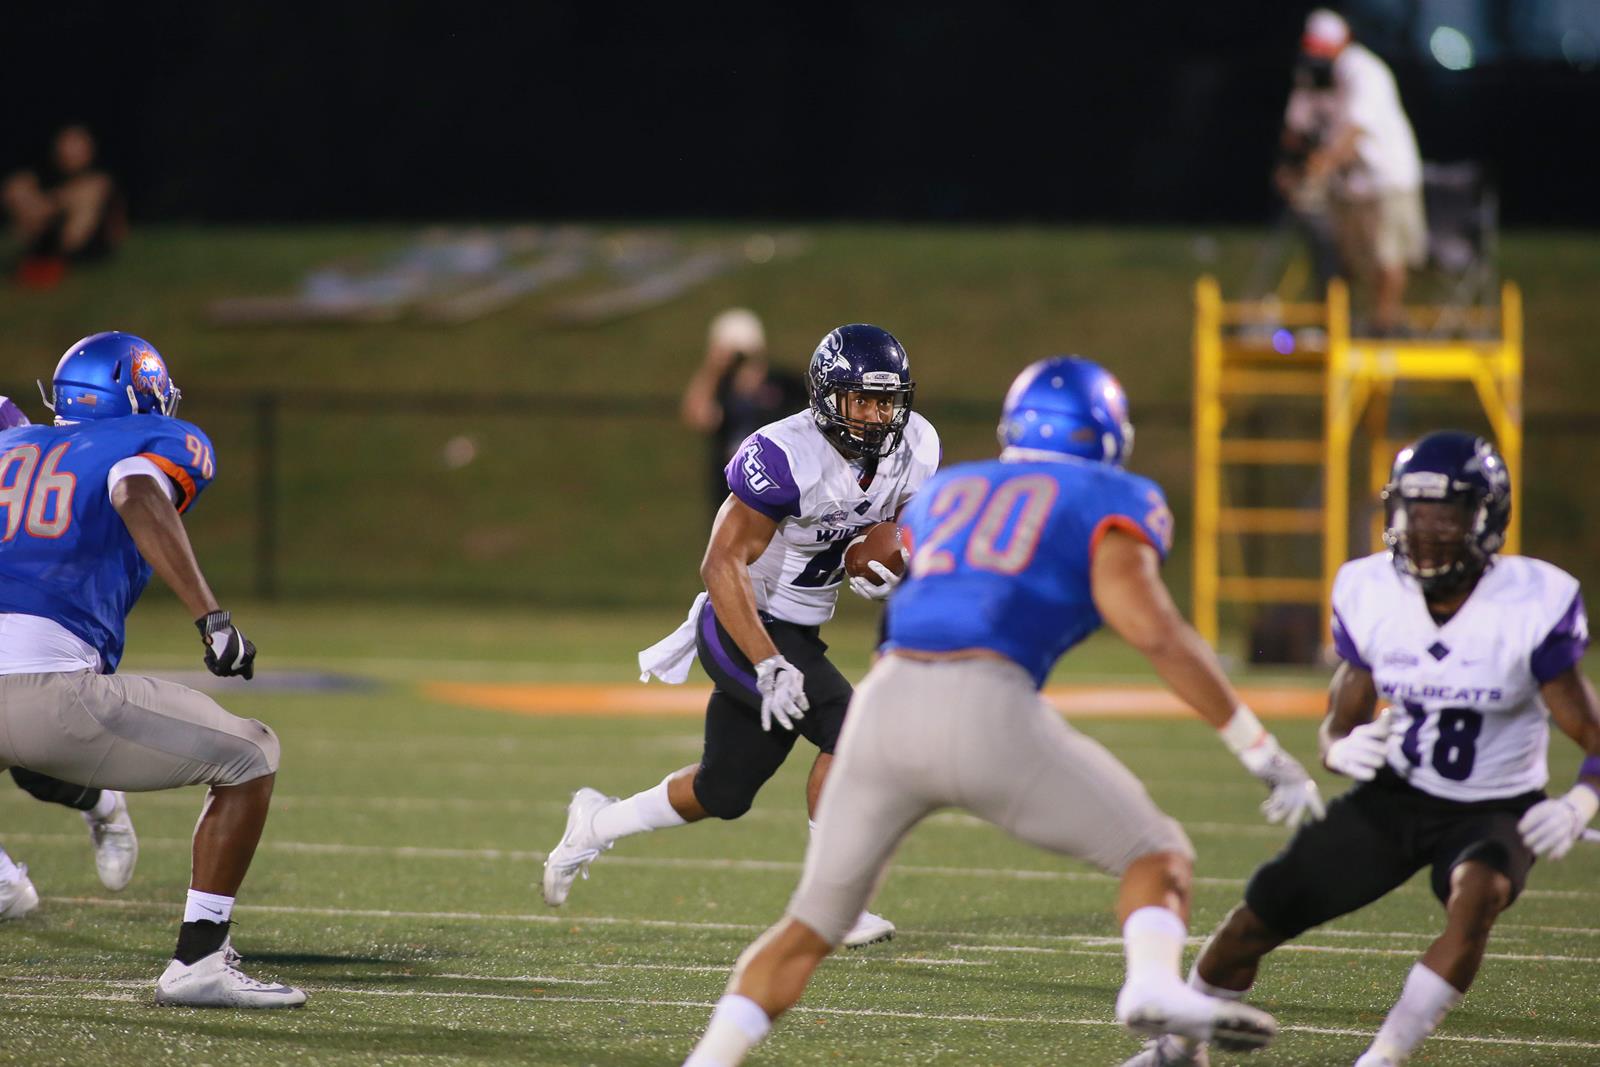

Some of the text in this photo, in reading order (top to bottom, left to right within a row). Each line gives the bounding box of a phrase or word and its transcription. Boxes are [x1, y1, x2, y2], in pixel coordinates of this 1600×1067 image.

[186, 432, 214, 480] 96
[742, 442, 777, 494] ACU
[0, 441, 77, 542] 96
[910, 473, 1059, 579] 20
[1382, 682, 1502, 701] WILDCATS
